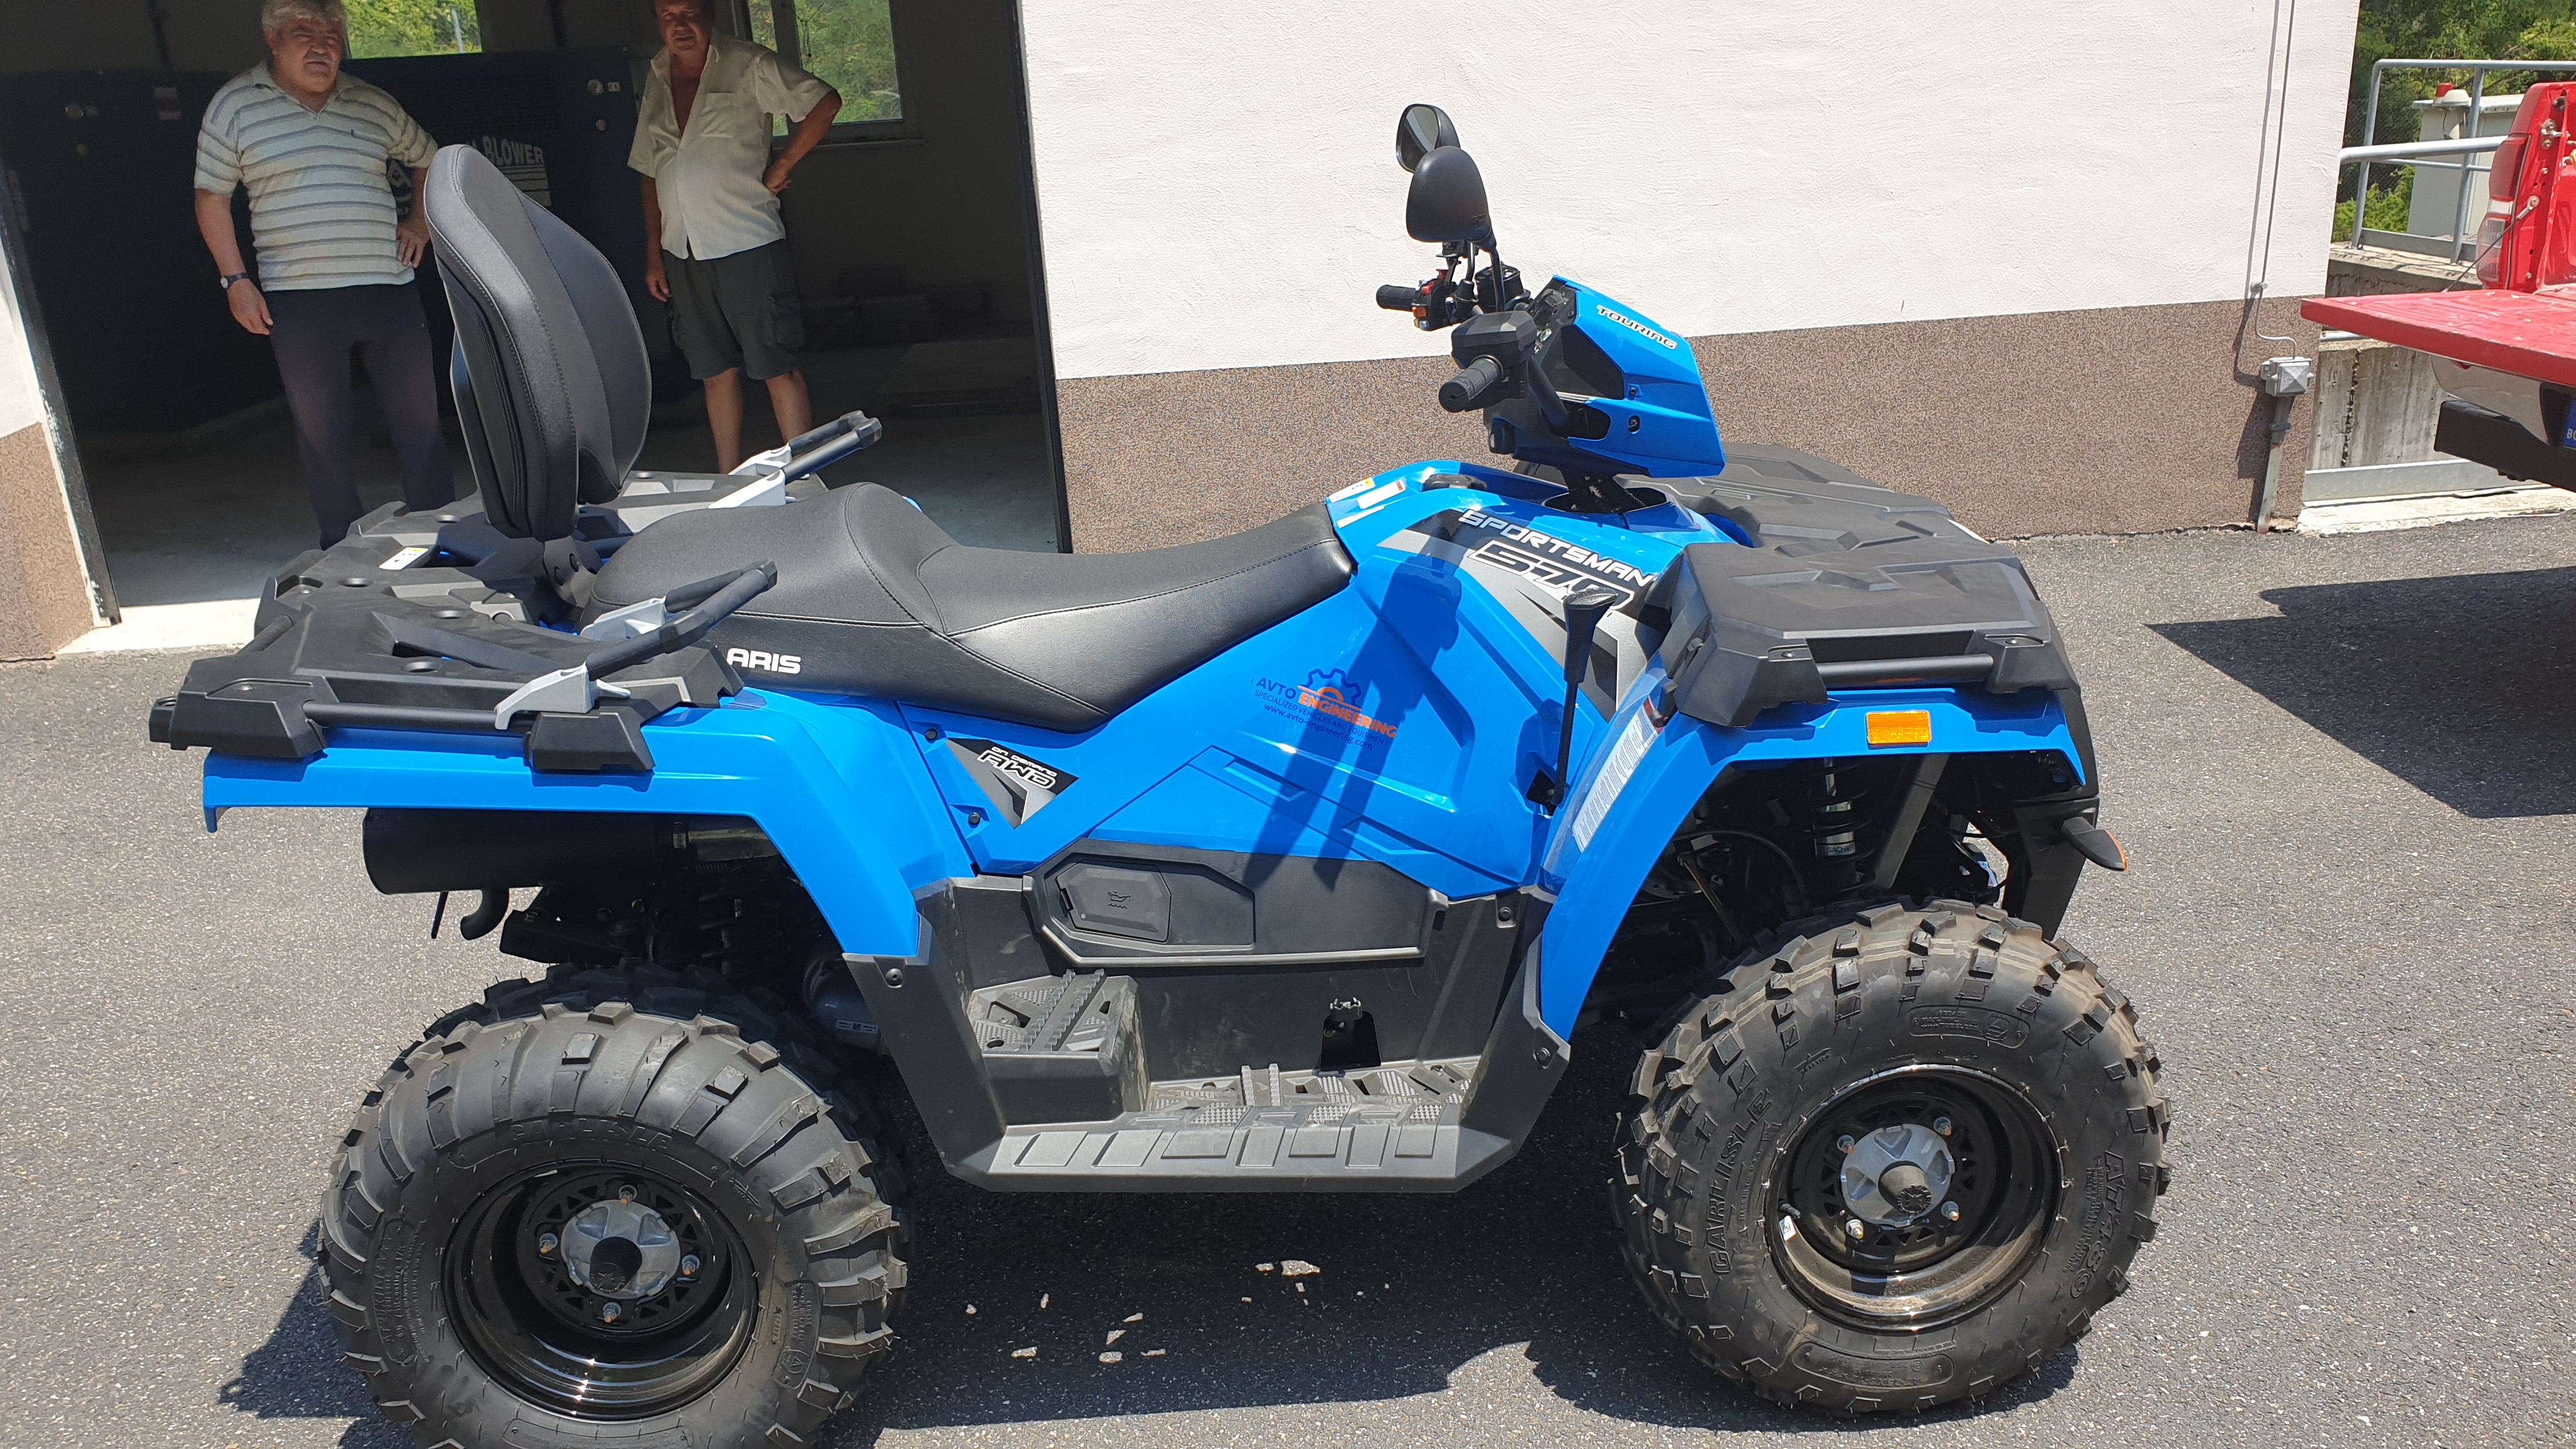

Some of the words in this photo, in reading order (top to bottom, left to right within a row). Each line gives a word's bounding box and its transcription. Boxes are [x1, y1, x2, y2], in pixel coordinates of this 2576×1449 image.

[482, 135, 544, 165] BLOWER
[1597, 305, 1677, 349] TOURING
[1458, 509, 1655, 586] SPORTSMAN
[1468, 540, 1635, 610] 570
[1254, 690, 1298, 711] SPECIALIZED
[1299, 706, 1331, 724] VEHICLES
[1332, 719, 1347, 730] AND
[1347, 726, 1389, 746] EQUIPMENT
[1255, 677, 1296, 699] AVTO
[1298, 692, 1397, 738] ENGINEERING
[1264, 703, 1373, 751] www.avto-engineering.com
[977, 749, 1056, 789] AWD
[1011, 755, 1057, 777] DEMAND
[1706, 1089, 1772, 1274] CARLISLE
